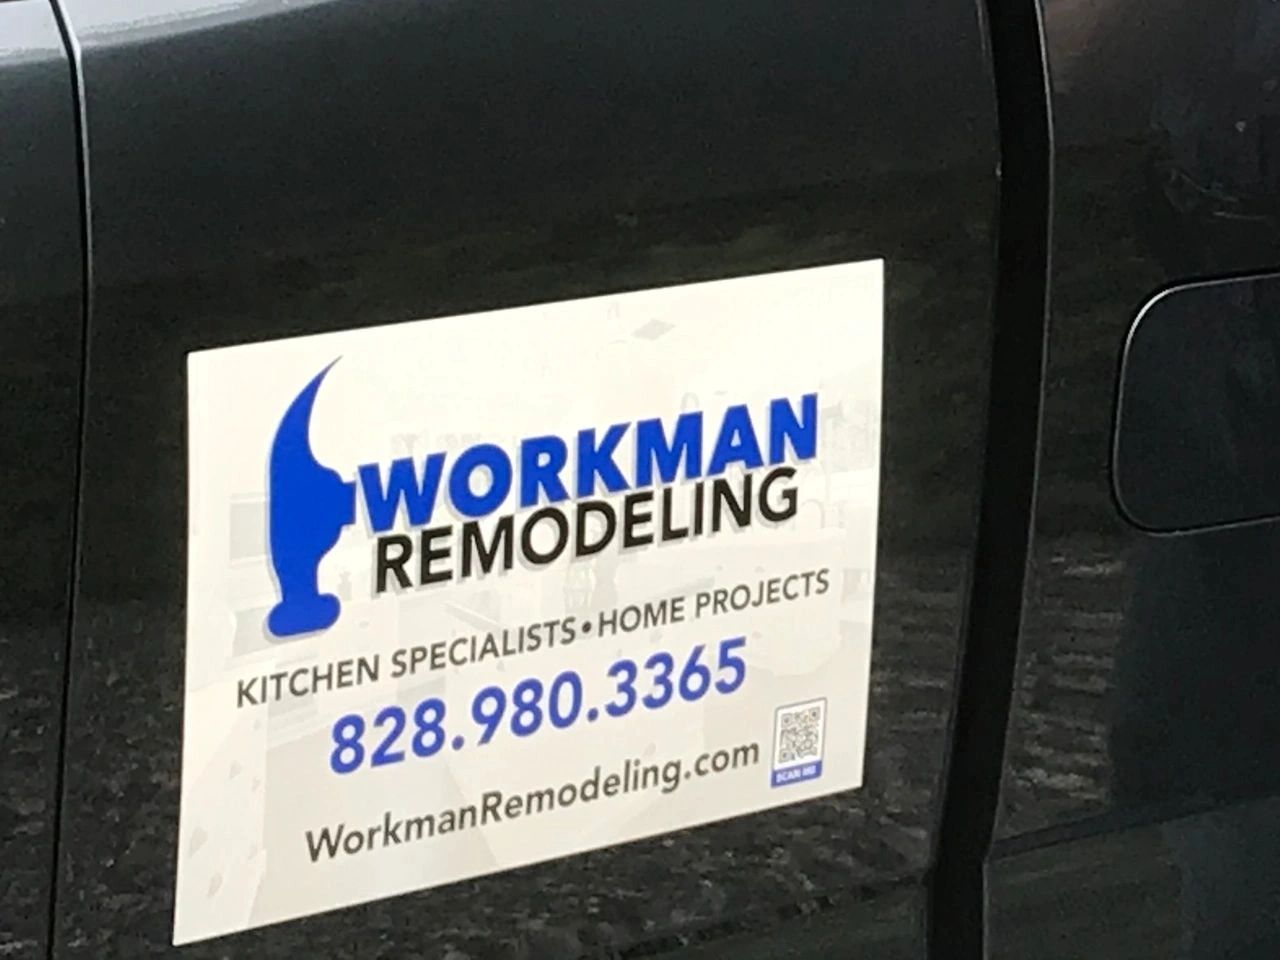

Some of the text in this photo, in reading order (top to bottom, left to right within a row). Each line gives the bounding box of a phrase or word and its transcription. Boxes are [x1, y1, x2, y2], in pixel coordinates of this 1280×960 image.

[358, 392, 819, 534] WORKMAN
[375, 466, 799, 594] REMODELING
[236, 568, 830, 708] KITCHEN SPECIALISTS HOME PROJECTS
[330, 637, 747, 775] 828.980.3365
[305, 743, 760, 863] WorkmanRemodeling.com
